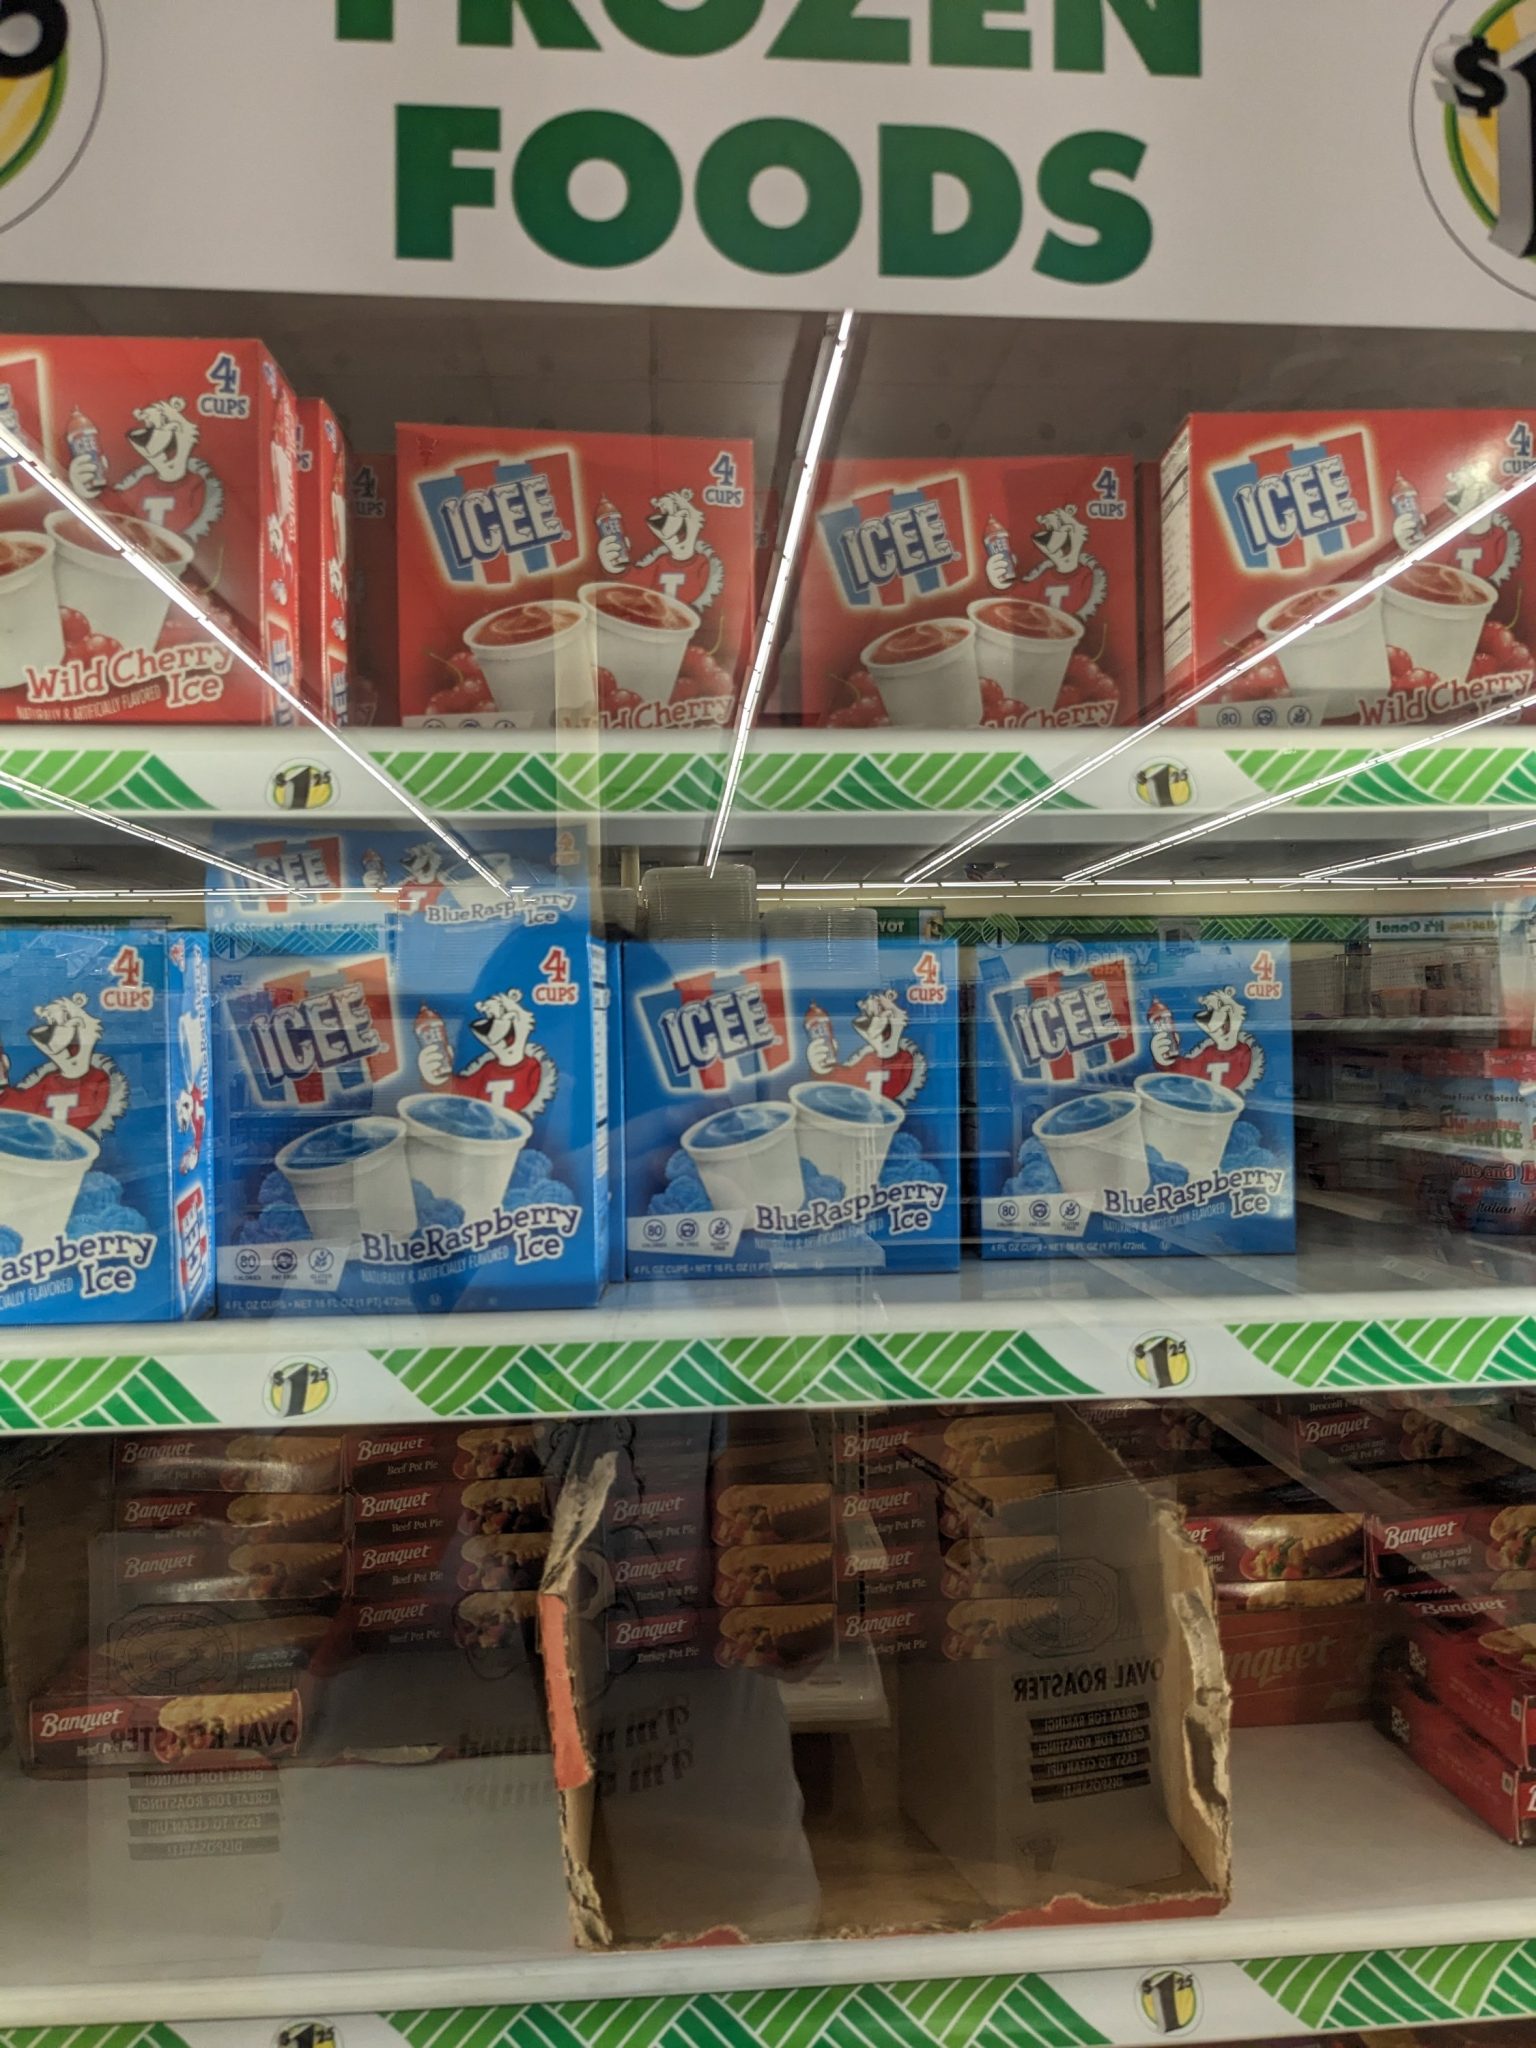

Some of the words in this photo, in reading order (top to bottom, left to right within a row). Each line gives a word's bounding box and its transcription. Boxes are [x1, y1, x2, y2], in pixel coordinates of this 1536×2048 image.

[336, 0, 1203, 78] ZEN
[395, 104, 1153, 286] FOODS
[207, 354, 239, 396] 4
[200, 398, 249, 417] CUPS
[1508, 424, 1532, 458] 4
[713, 453, 735, 487] 4
[1095, 468, 1117, 500] 4
[704, 489, 745, 507] CUPS
[1086, 501, 1126, 518] CUPS
[1234, 454, 1360, 557] ICEE
[441, 473, 566, 566] ICEE
[841, 500, 954, 593] ICEE
[26, 664, 105, 703] Wild
[112, 645, 236, 686] Cherry
[167, 676, 225, 708] Ice
[1358, 684, 1427, 727] Wild
[1429, 670, 1535, 714] Cherry
[561, 709, 629, 729] ld
[632, 696, 734, 729] Cherry
[239, 848, 333, 893] CEE
[525, 907, 557, 926] Ice
[113, 948, 141, 987] 4
[543, 949, 568, 984] 4
[914, 954, 938, 985] 4
[1252, 951, 1274, 982] 4
[103, 989, 154, 1010] CUPS
[533, 985, 578, 1003] CUPS
[907, 986, 945, 1002] CUPS
[1246, 982, 1282, 998] CUPS
[250, 983, 383, 1089] ICEE
[660, 983, 775, 1077] ICEE
[1012, 982, 1122, 1068] ICEE
[1104, 1169, 1283, 1216] BlueRaspberry
[1232, 1194, 1269, 1219] Ice
[755, 1181, 947, 1233] BlueRaspberry
[889, 1207, 930, 1235] Ice
[1001, 1205, 1016, 1217] 80
[361, 1203, 581, 1263] BlueRaspberry
[648, 1224, 662, 1237] 80
[0, 1233, 155, 1285] aspberry
[239, 1254, 256, 1270] 80
[516, 1236, 564, 1263] Ice
[82, 1267, 136, 1297] Ice
[1304, 1415, 1372, 1444] Banquet
[121, 1440, 196, 1465] Banquet
[356, 1437, 425, 1462] Banquet
[842, 1430, 912, 1458] Banquet
[424, 1460, 439, 1471] Pie
[124, 1501, 197, 1524] Banquet
[360, 1490, 432, 1518] Banquet
[613, 1495, 685, 1523] Banquet
[842, 1489, 913, 1519] Banquet
[391, 1521, 412, 1534] Beef
[412, 1520, 431, 1532] Pot
[431, 1517, 445, 1529] Pie
[911, 1517, 927, 1529] Pie
[1384, 1519, 1457, 1551] Banquet
[361, 1544, 431, 1570] Banquet
[843, 1550, 915, 1578] Banquet
[1454, 1544, 1473, 1557] and
[124, 1553, 197, 1580] Banquet
[614, 1556, 687, 1585] Banquet
[911, 1576, 928, 1589] Pie
[358, 1602, 430, 1629] Banquet
[1419, 1598, 1508, 1617] Banquet
[615, 1617, 688, 1645] Banquet
[844, 1610, 916, 1638] Banquet
[683, 1645, 700, 1658] Pie
[912, 1637, 929, 1650] Pie
[1226, 1634, 1340, 1689] nquet
[40, 1708, 124, 1737] Banquet
